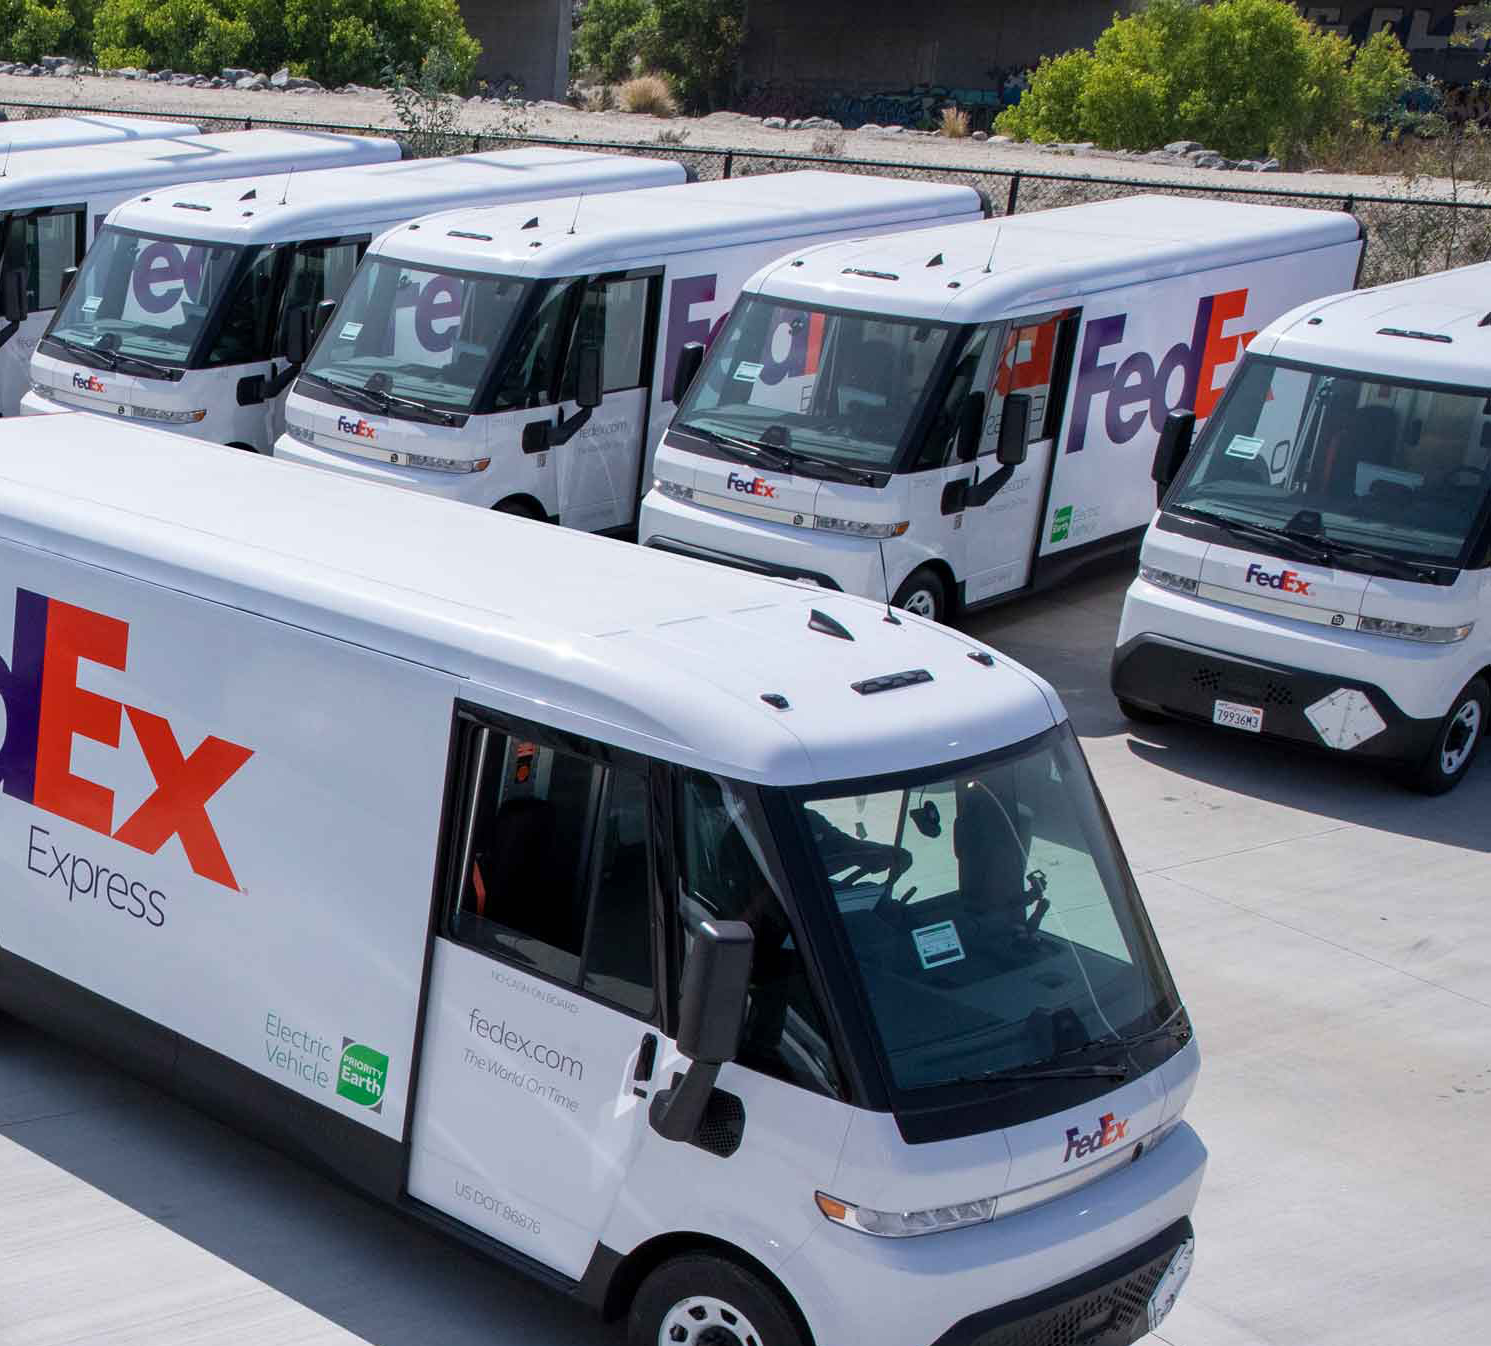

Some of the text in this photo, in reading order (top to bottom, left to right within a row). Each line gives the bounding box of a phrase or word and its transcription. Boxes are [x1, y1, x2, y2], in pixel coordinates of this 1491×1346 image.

[73, 372, 104, 393] FedEx
[338, 415, 375, 439] FedEx
[727, 471, 776, 498] FedEx
[1245, 563, 1312, 596] FedEx
[1216, 708, 1259, 729] 79936M3
[27, 824, 166, 928] Express
[265, 1011, 333, 1062] Electric
[469, 1008, 584, 1081] fedex.com
[265, 1040, 329, 1089] Vehicle
[340, 1065, 381, 1098] Earth
[343, 1054, 384, 1080] PRIORITY
[463, 1048, 581, 1113] The World On Time
[1063, 1112, 1129, 1163] FedEx
[454, 1179, 473, 1201] US
[473, 1189, 503, 1215] DOT
